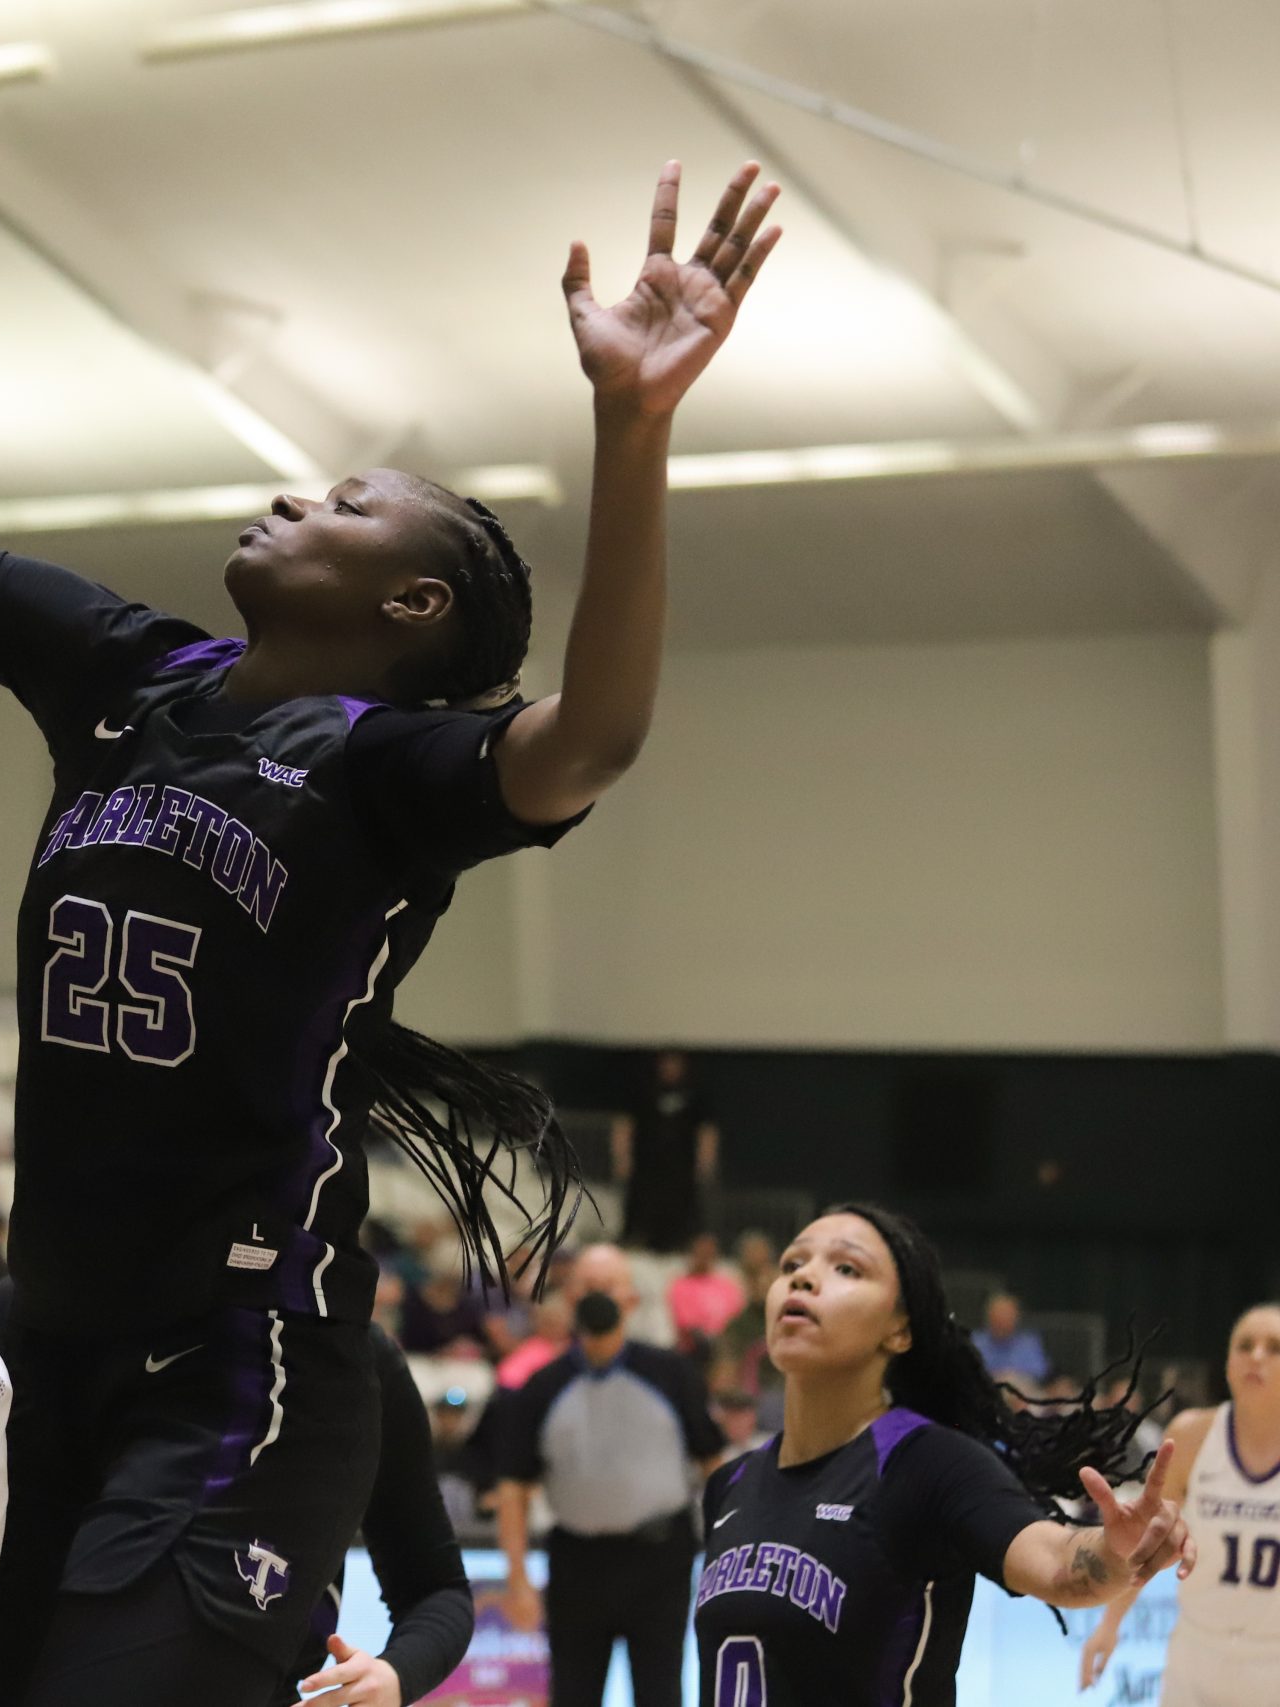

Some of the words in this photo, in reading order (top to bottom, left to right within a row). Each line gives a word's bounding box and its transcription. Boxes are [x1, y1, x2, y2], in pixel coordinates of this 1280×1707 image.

[258, 757, 309, 787] WAC
[41, 894, 202, 1068] 25
[252, 1223, 265, 1241] L
[697, 1542, 847, 1634] ARLETON
[1220, 1532, 1280, 1589] 10
[714, 1635, 768, 1707] 0
